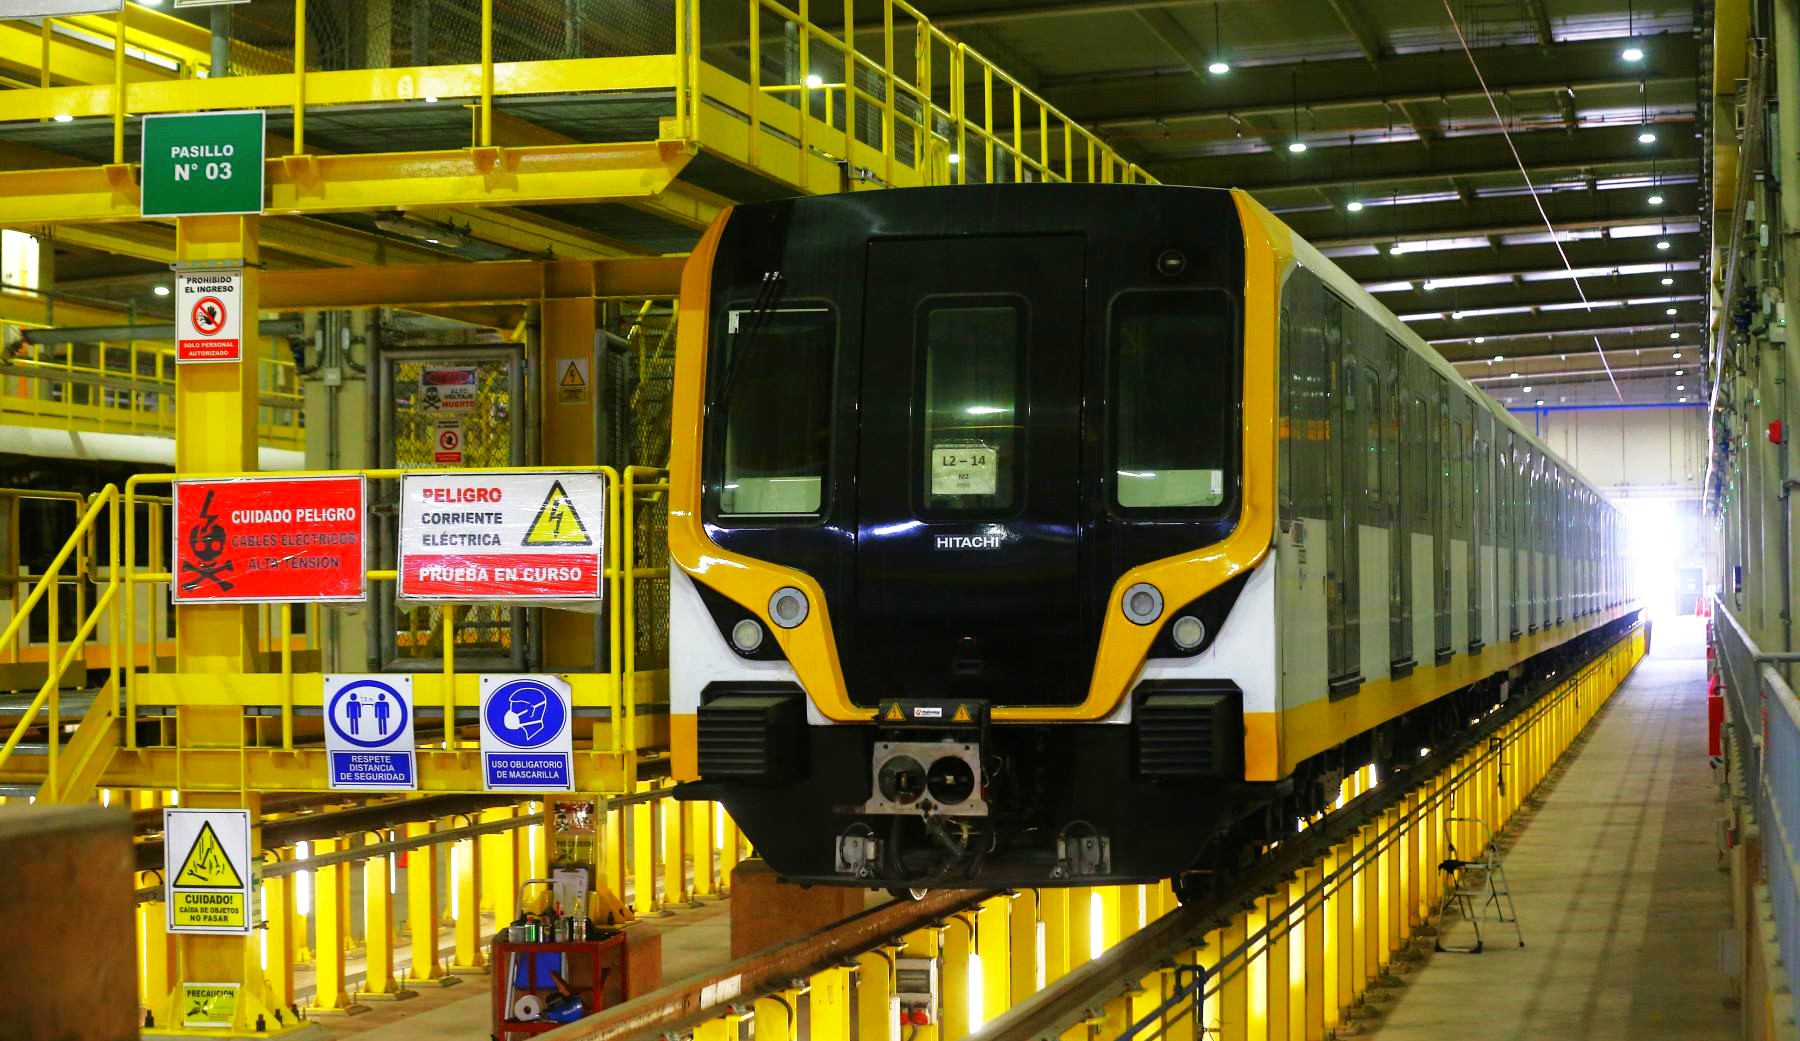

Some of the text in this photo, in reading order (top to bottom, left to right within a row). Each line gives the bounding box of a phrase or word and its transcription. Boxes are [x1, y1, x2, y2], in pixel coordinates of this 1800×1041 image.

[171, 144, 234, 158] PASILLO
[174, 162, 232, 181] N° 03
[186, 276, 232, 284] PROHIBIDO
[197, 285, 234, 293] INGRESO
[943, 456, 956, 467] L2
[971, 456, 986, 466] 14
[422, 487, 502, 503] PELIGRO
[231, 507, 356, 524] CUIDADO PELIGRO
[421, 512, 503, 525] CORRIENTE
[232, 534, 277, 547] CABLES
[422, 531, 502, 547] ELÉCTRICA
[936, 536, 1000, 548] HITACHI
[249, 556, 339, 570] ALTA TENSION
[418, 567, 582, 582] PRUEBA EN CURSO
[351, 755, 391, 763] RESPETE
[491, 760, 563, 768] USO OBLIGATORIO
[349, 764, 395, 772] DISTANCIA
[354, 773, 405, 781] SEGURIDAD
[496, 770, 560, 779] DE MASCARILLA
[185, 895, 233, 904] CUIDADO!
